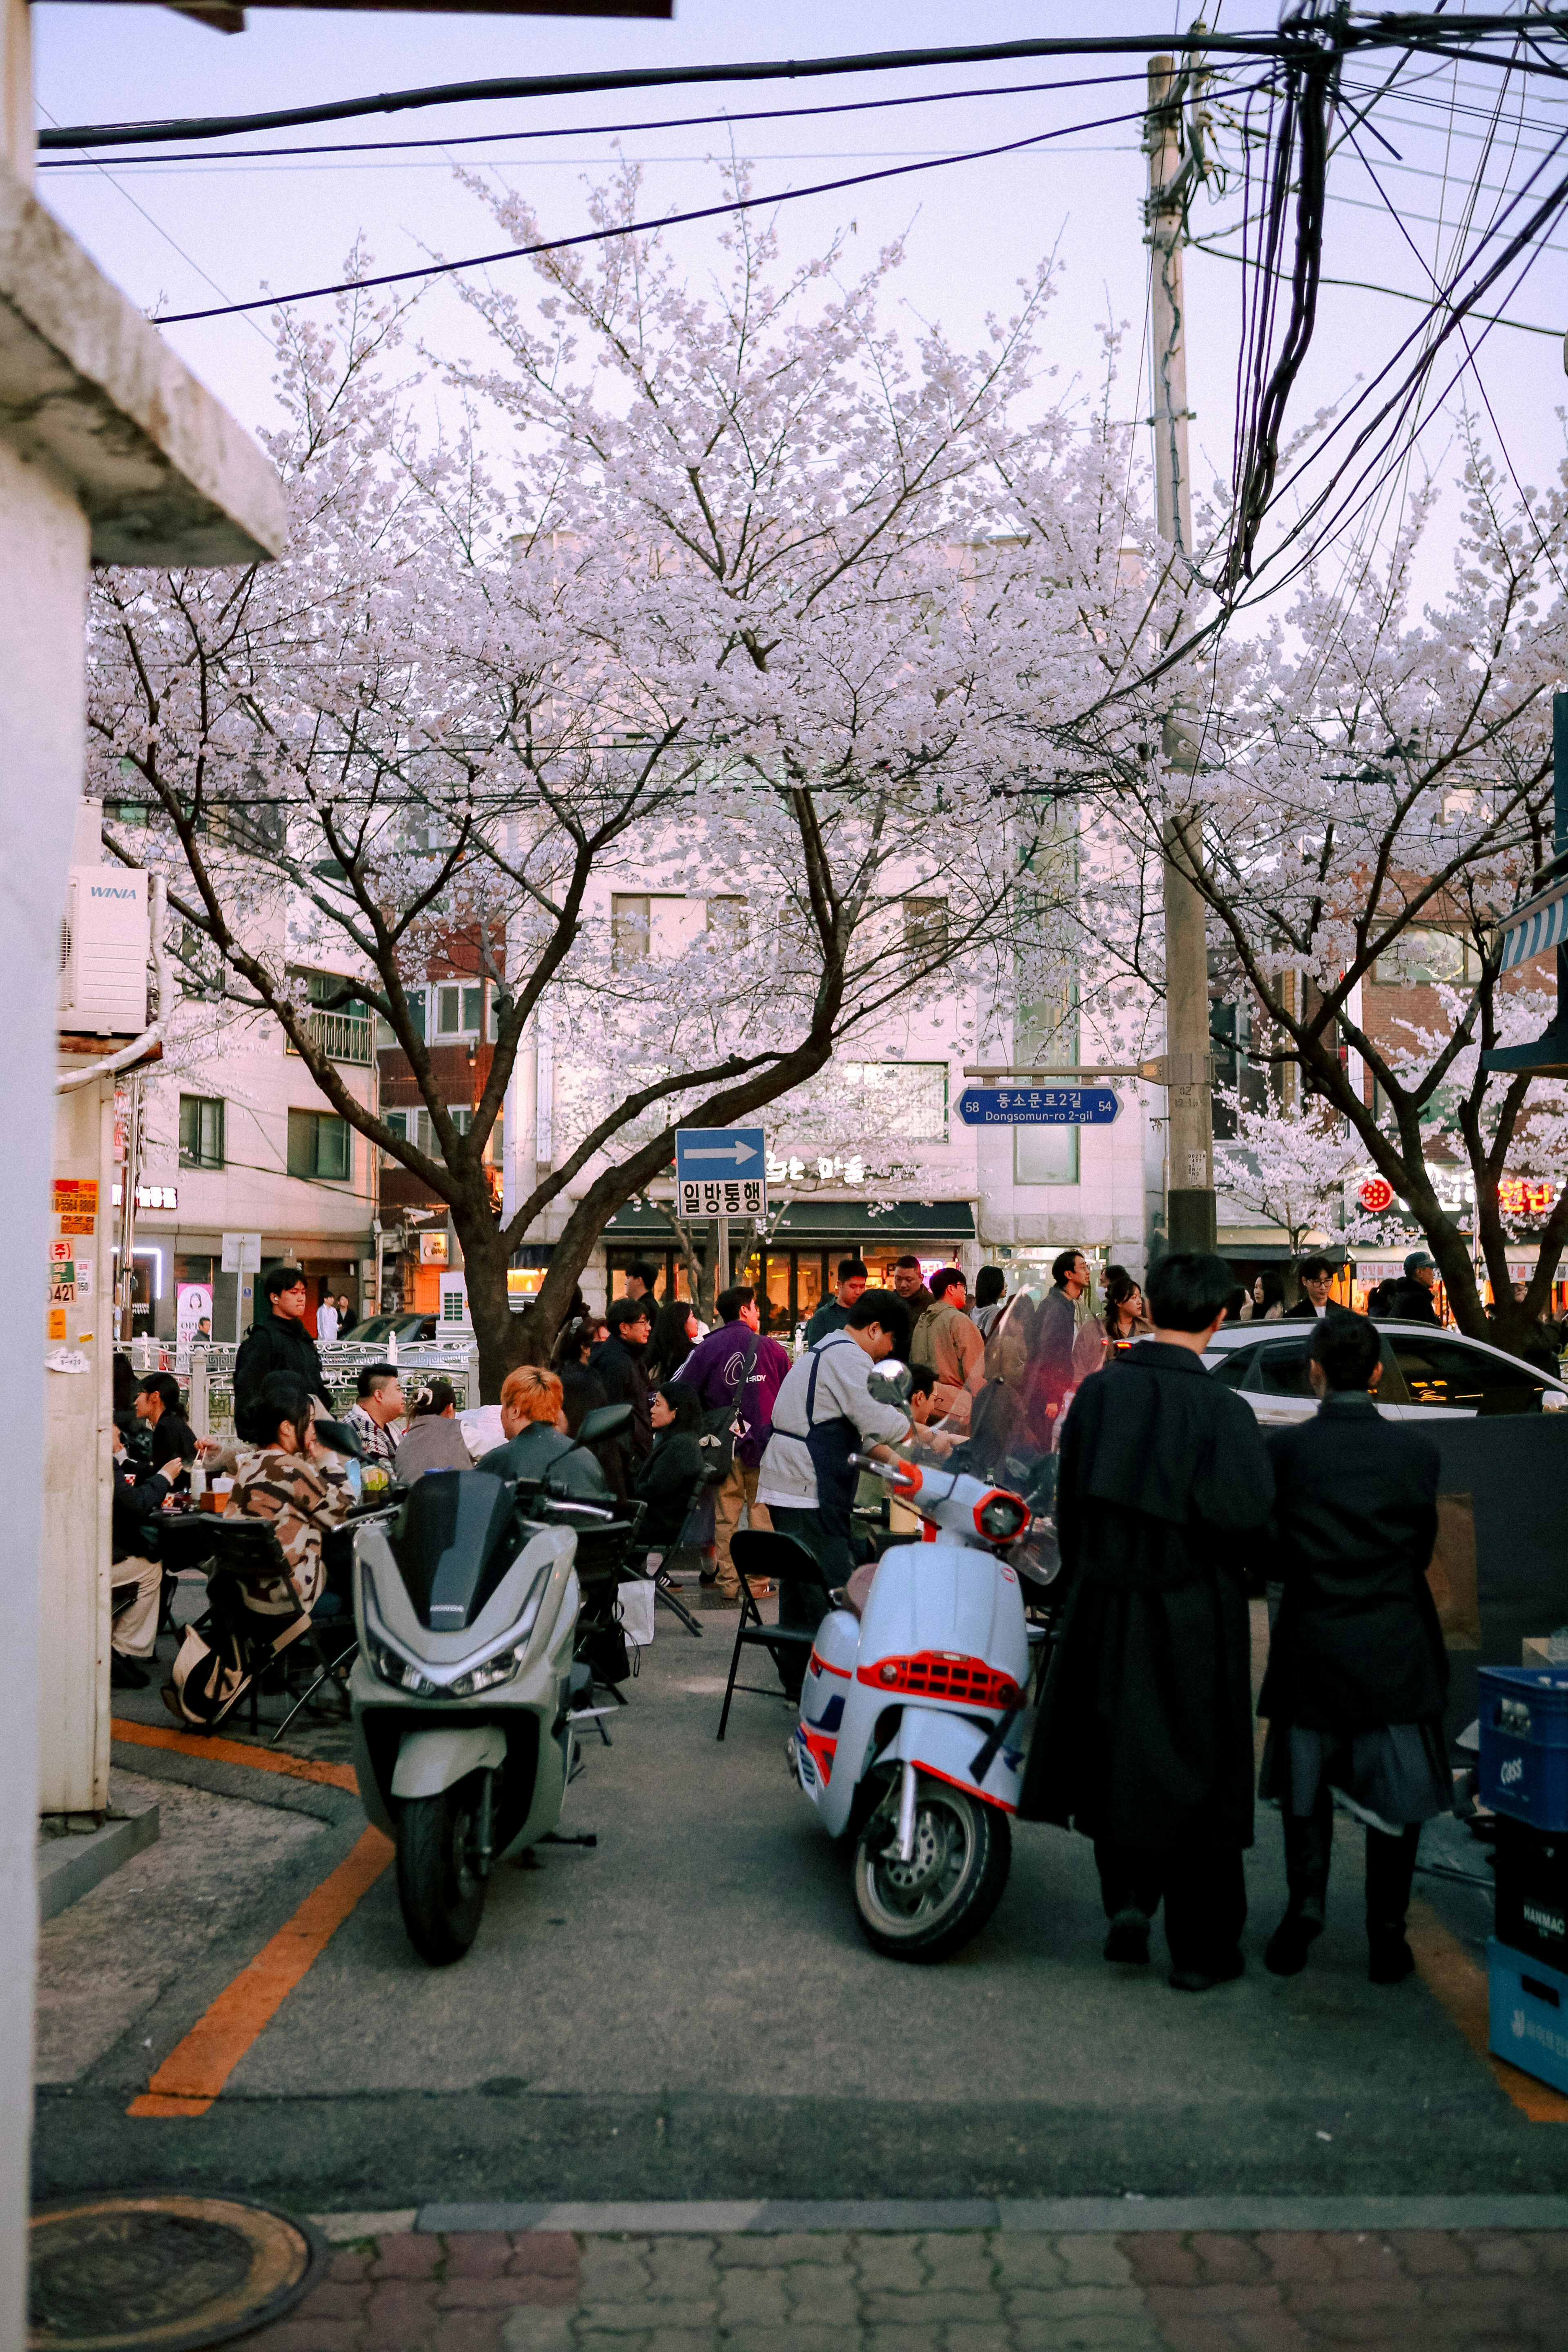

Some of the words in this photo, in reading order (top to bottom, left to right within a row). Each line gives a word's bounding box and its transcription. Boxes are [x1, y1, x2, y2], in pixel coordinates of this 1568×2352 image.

[91, 886, 136, 900] WINIA
[966, 1102, 979, 1112] 58
[997, 1092, 1081, 1109] 동소문로2길
[1099, 1101, 1112, 1111] 54
[986, 1111, 1065, 1123] Dongsomun-ro
[1068, 1111, 1092, 1122] 2-gil
[684, 1182, 760, 1213] 일방통행
